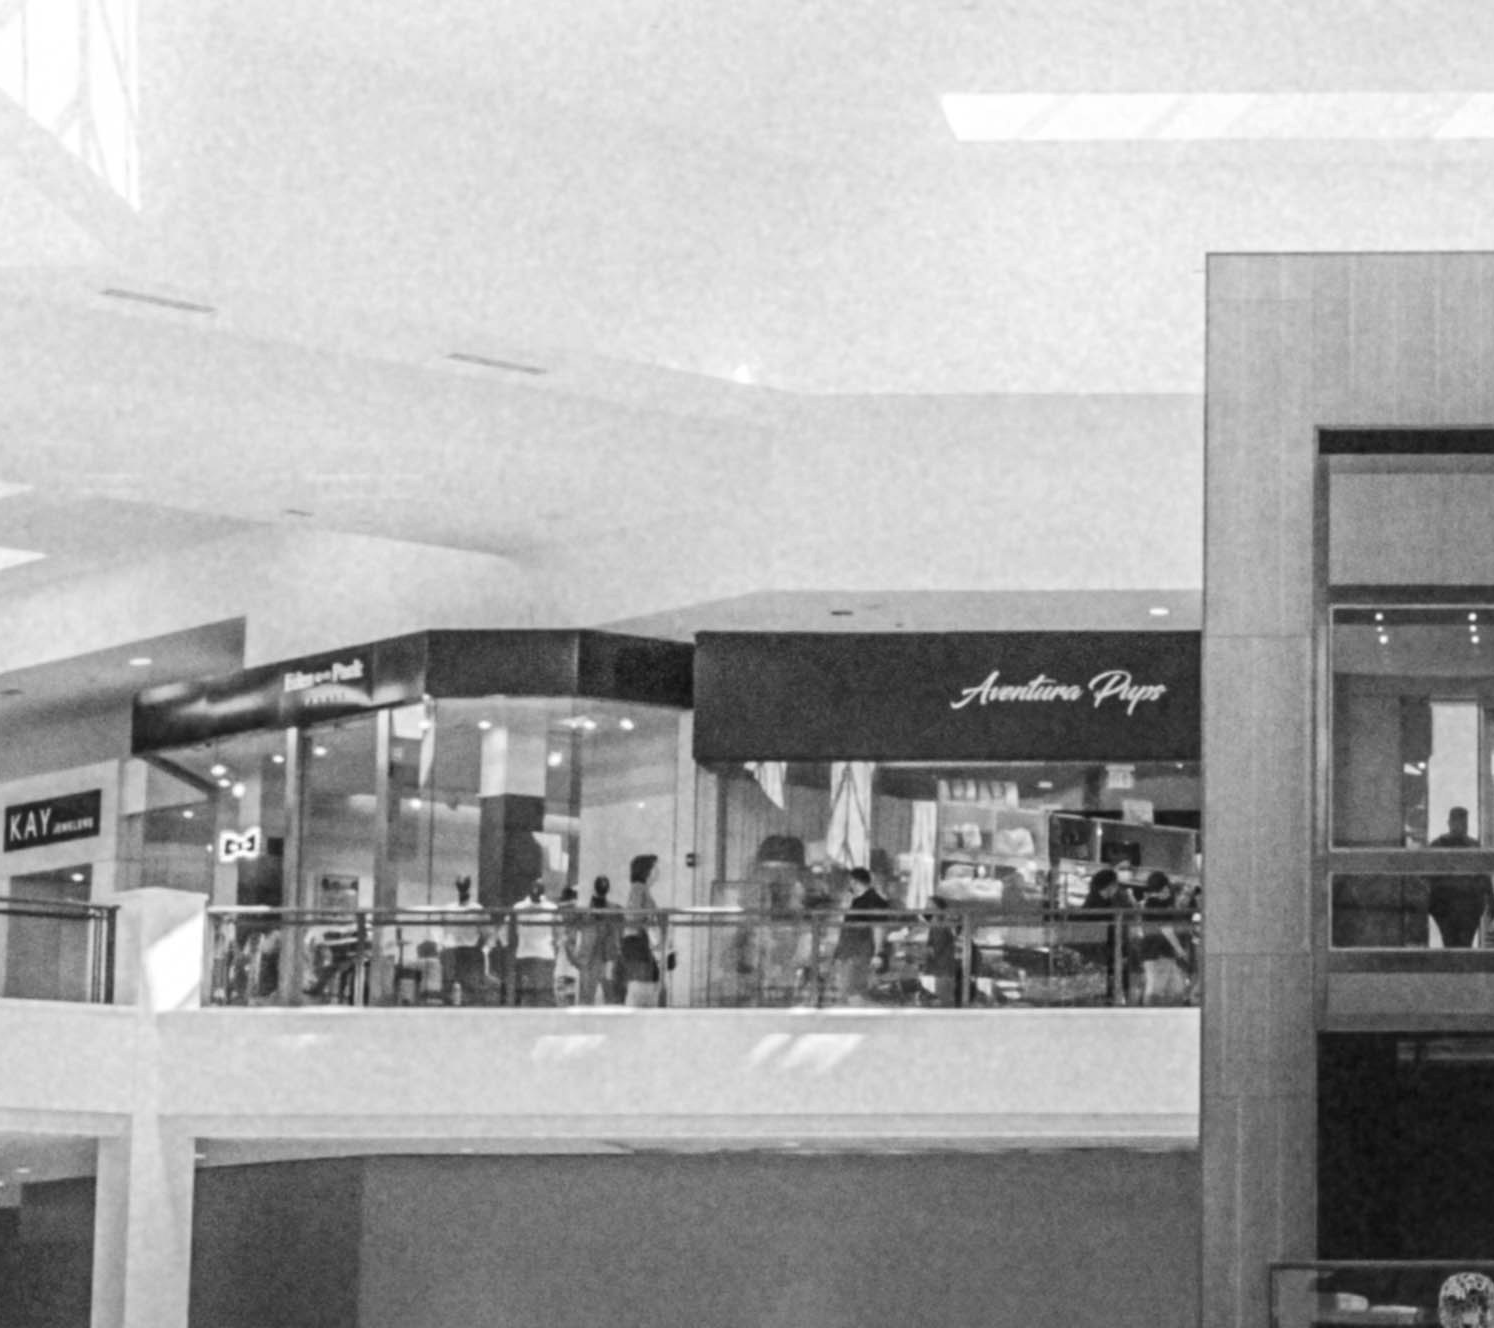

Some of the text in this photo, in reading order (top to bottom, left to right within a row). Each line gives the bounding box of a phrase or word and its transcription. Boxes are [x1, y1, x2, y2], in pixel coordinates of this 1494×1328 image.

[950, 669, 1168, 717] Aventura Pups
[9, 807, 53, 842] KAY
